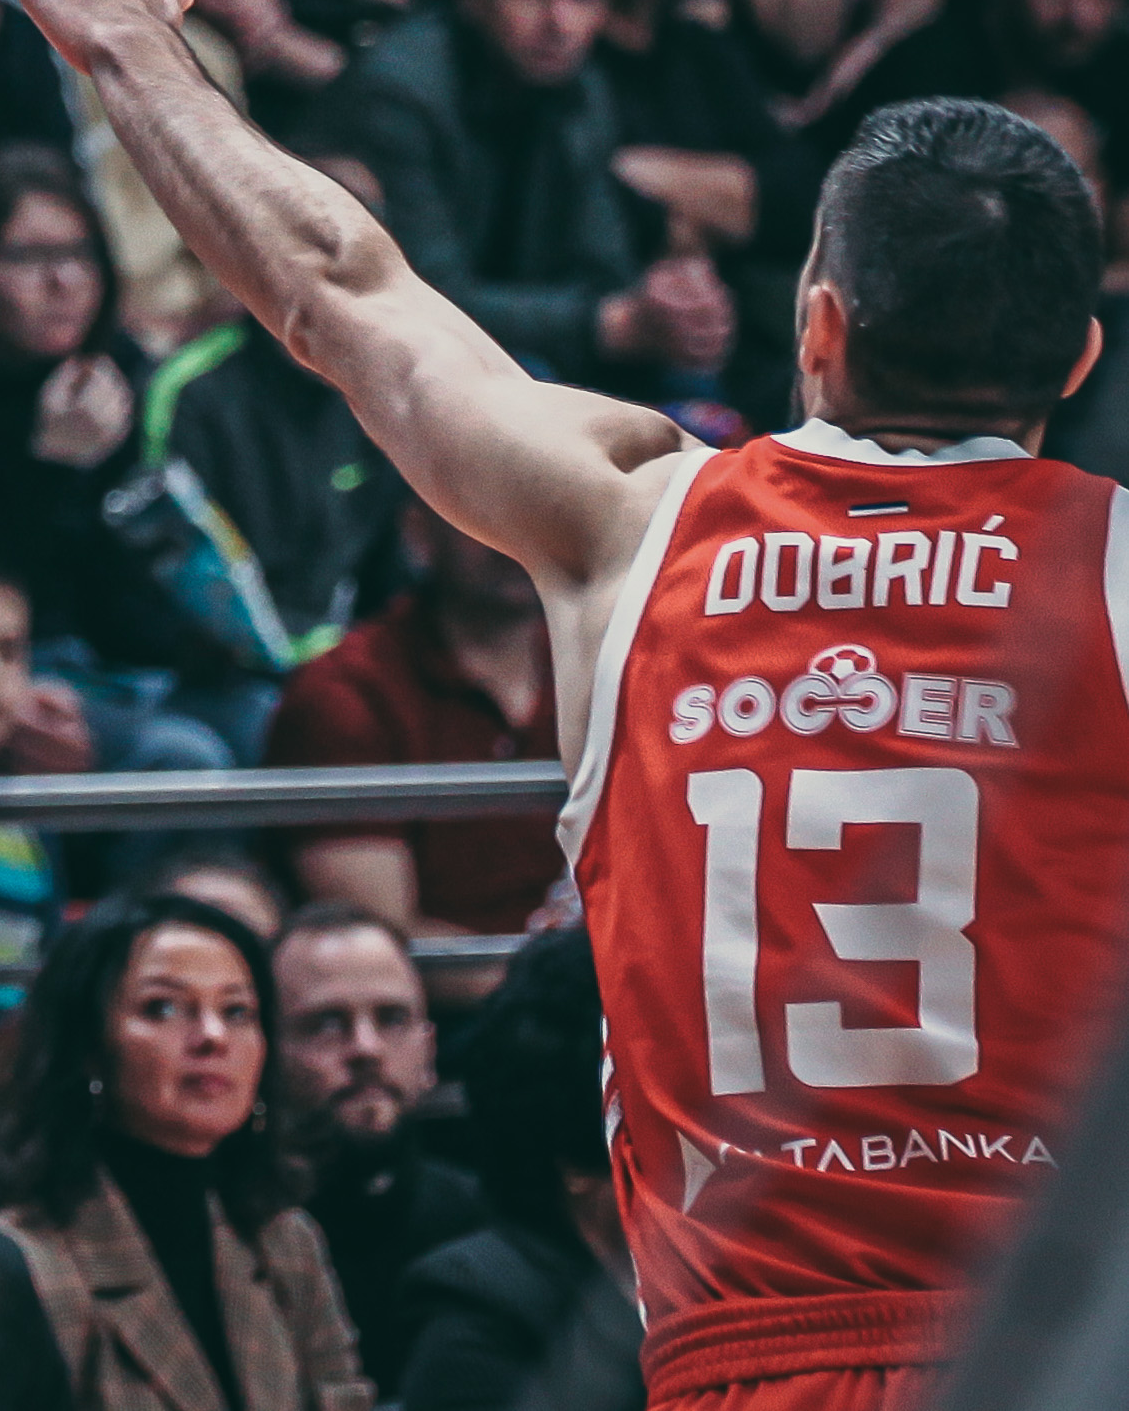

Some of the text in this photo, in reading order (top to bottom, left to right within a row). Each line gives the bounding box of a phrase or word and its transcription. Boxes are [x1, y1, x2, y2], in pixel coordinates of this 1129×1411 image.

[704, 515, 1019, 616] DOBRIĆ
[670, 671, 1020, 749] SOCCER
[687, 766, 979, 1096] 13
[720, 1129, 1058, 1172] TABANKA
